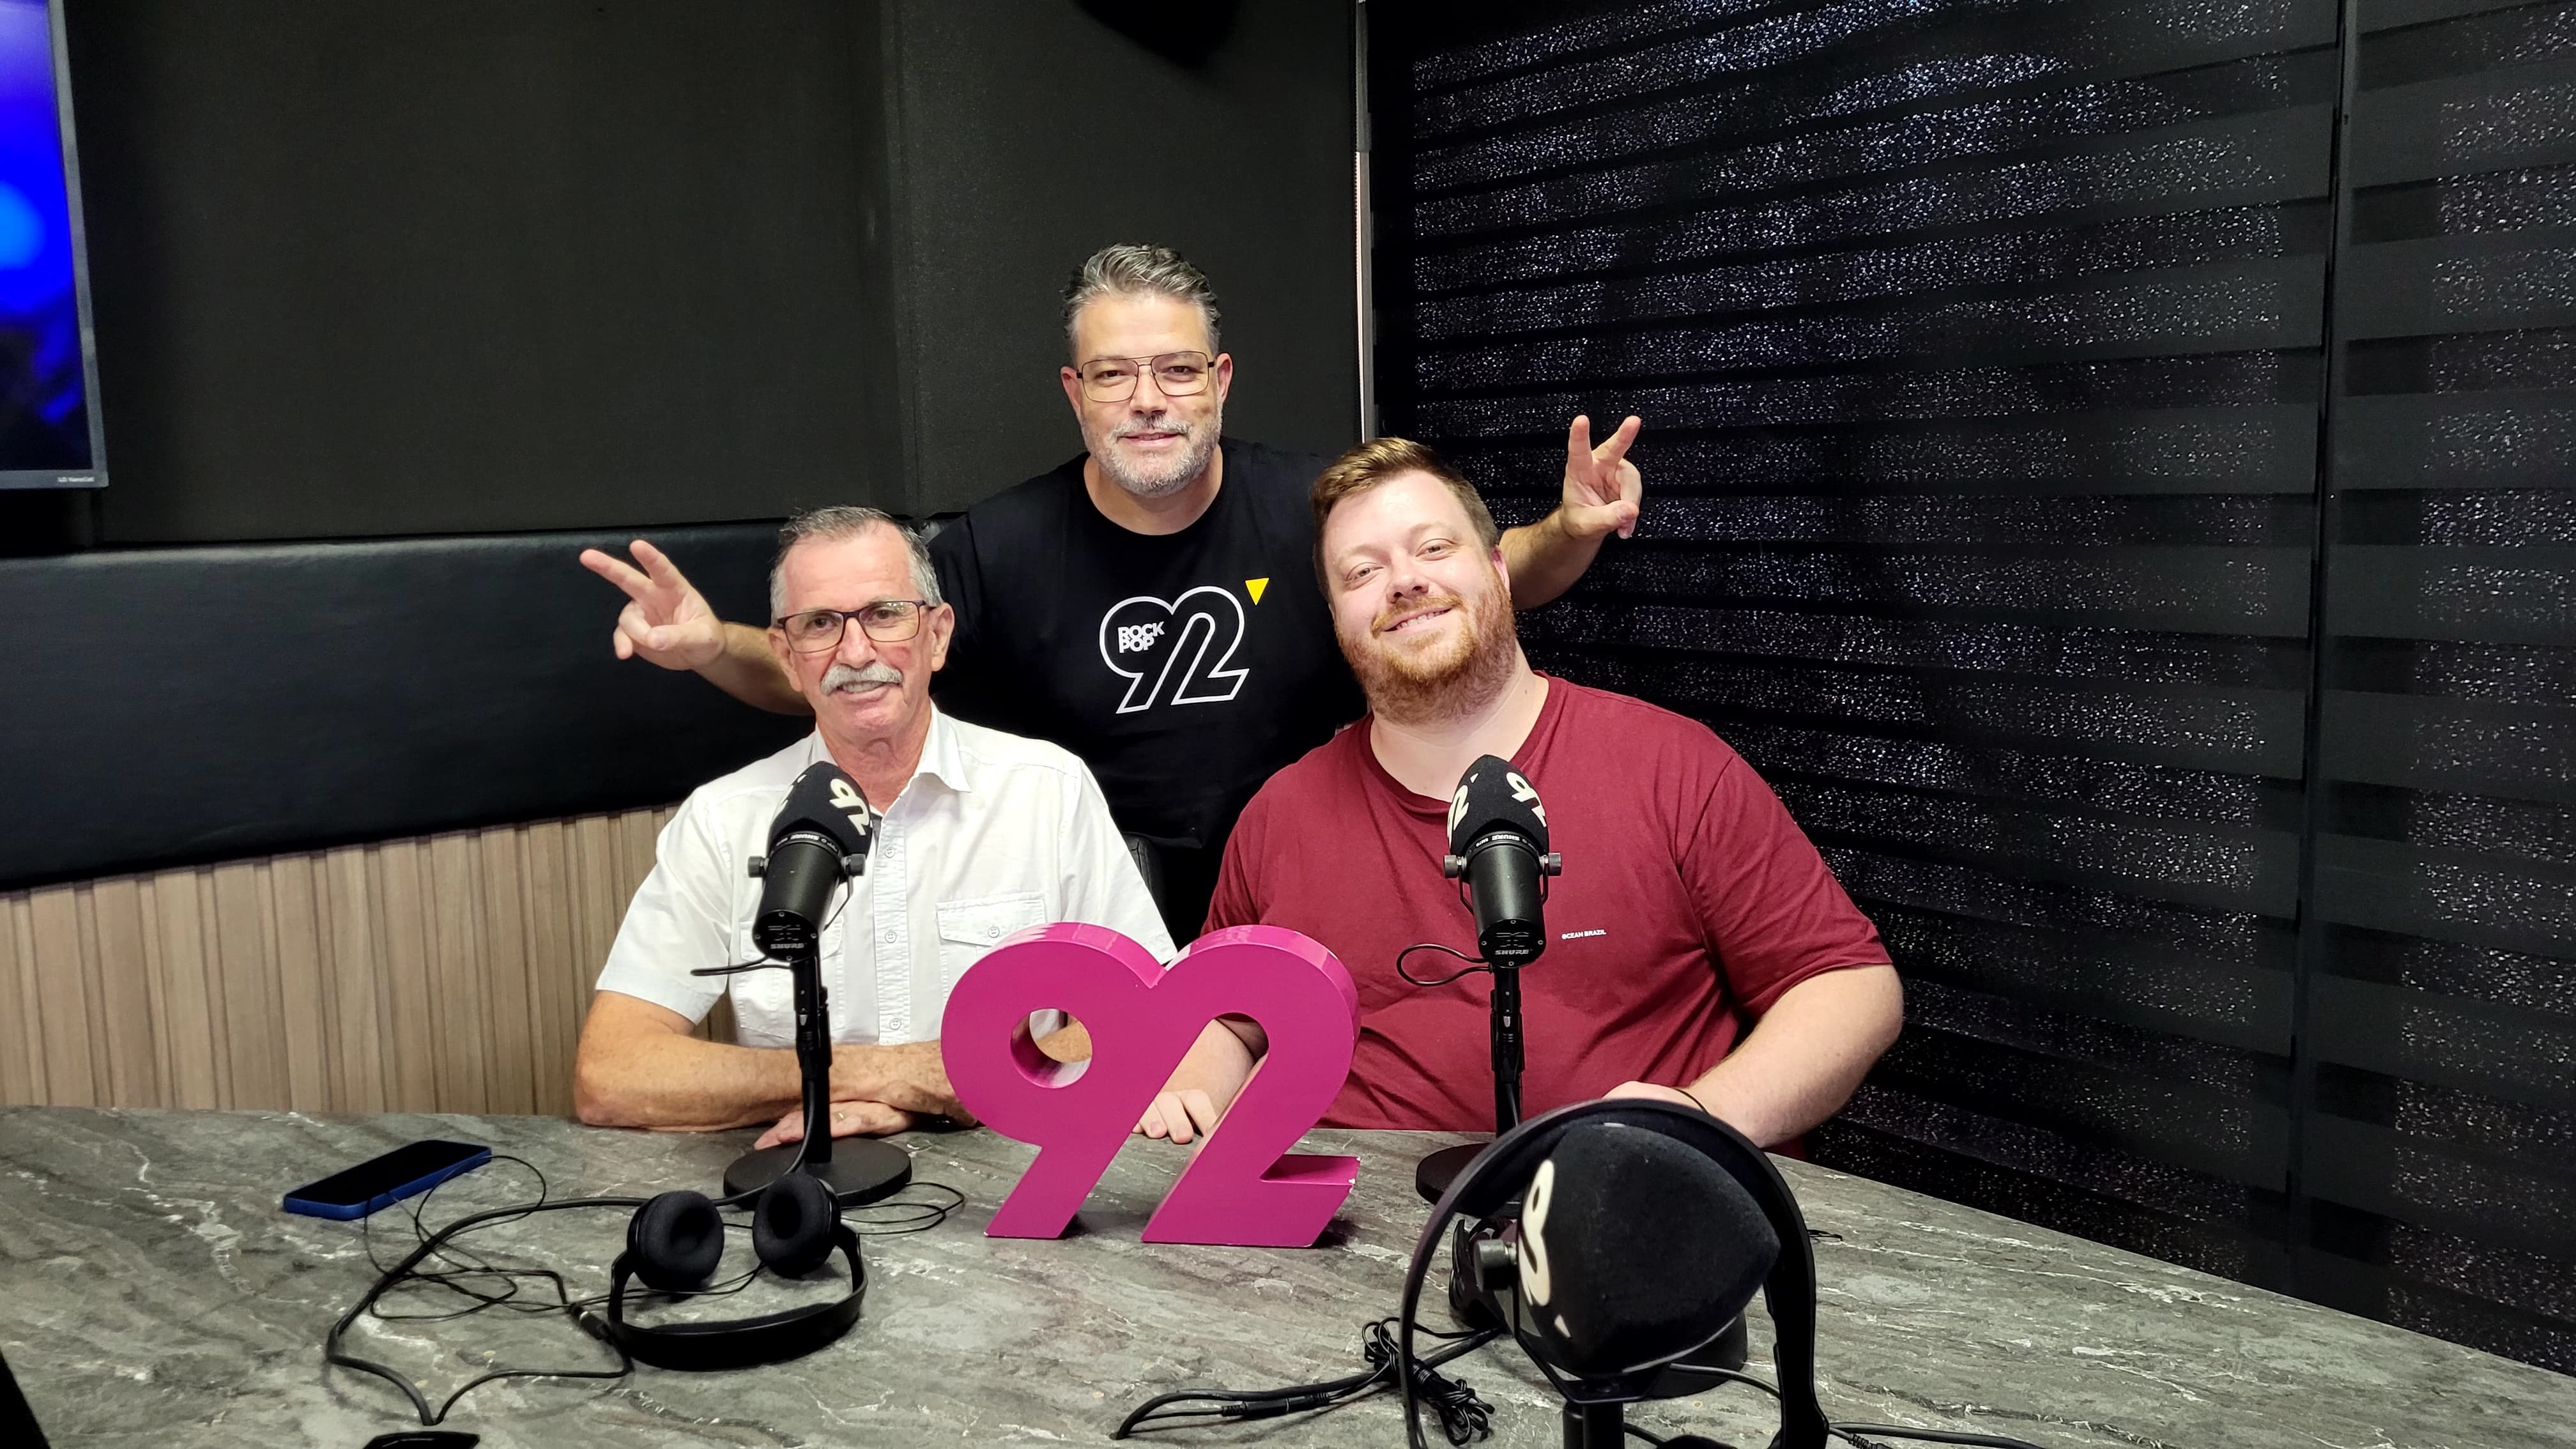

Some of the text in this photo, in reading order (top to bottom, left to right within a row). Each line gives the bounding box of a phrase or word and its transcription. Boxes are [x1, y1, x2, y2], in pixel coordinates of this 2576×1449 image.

[1118, 621, 1165, 640] ROCK
[1099, 585, 1250, 714] 92
[1119, 636, 1154, 653] POP
[1584, 929, 1607, 937] BRAZIL
[940, 921, 1361, 1248] 92
